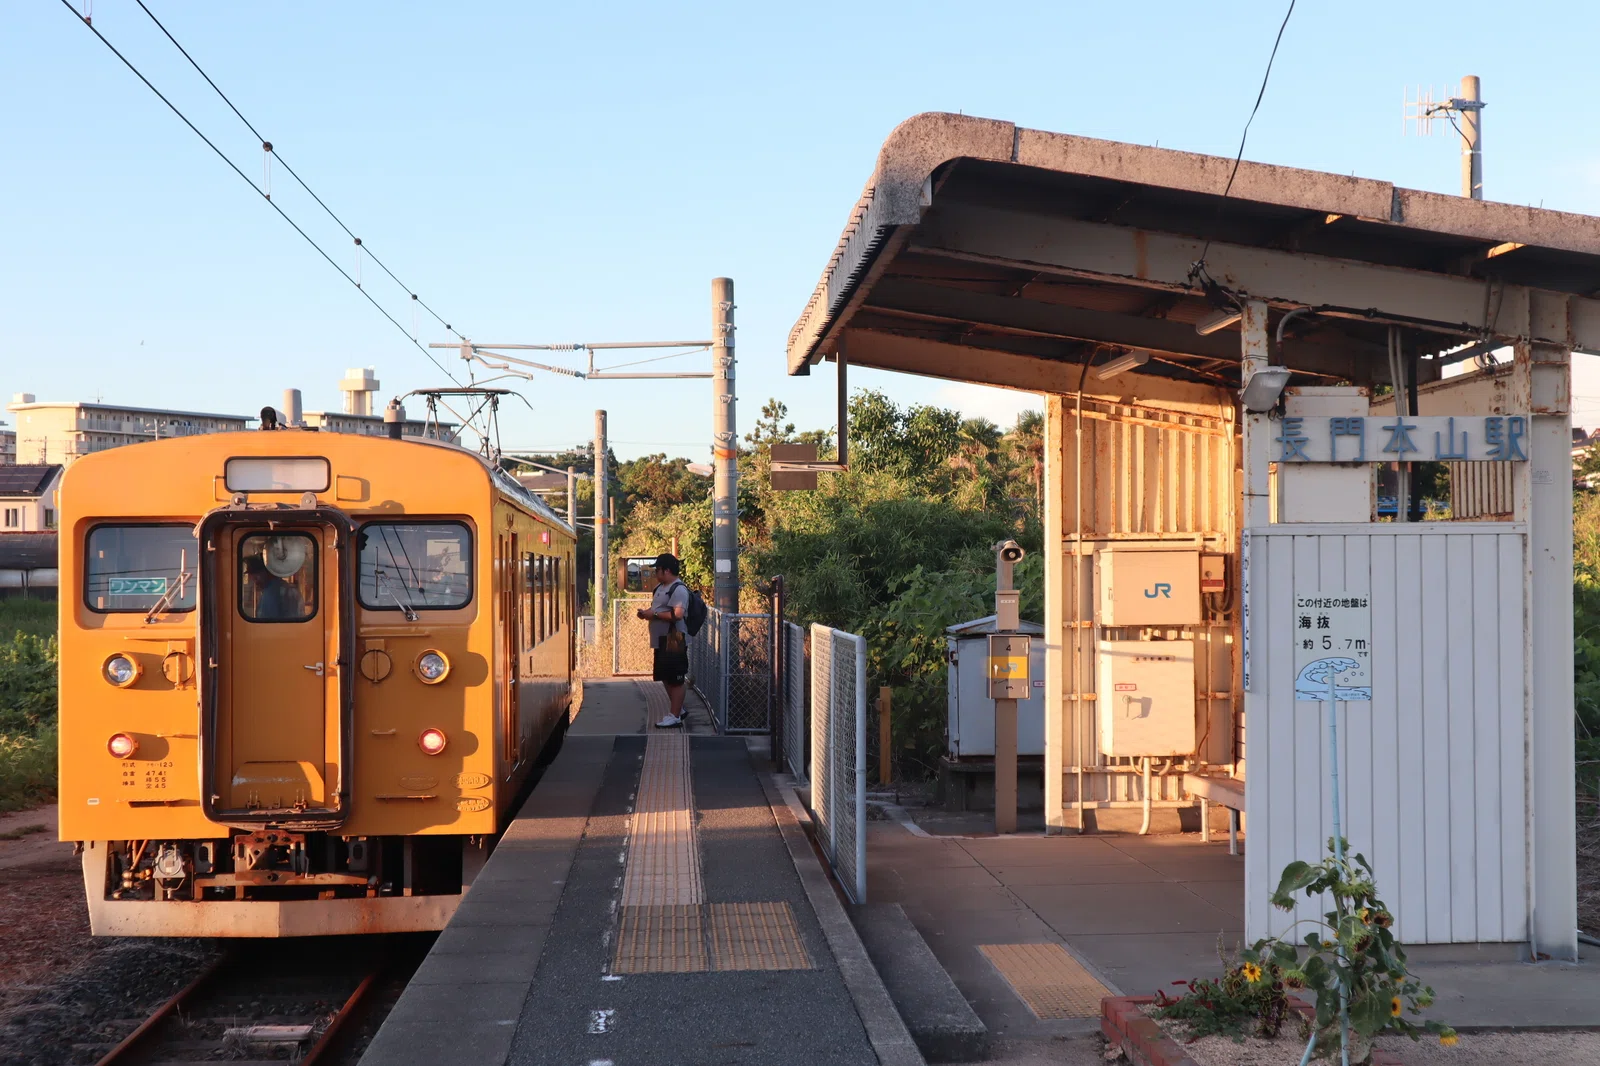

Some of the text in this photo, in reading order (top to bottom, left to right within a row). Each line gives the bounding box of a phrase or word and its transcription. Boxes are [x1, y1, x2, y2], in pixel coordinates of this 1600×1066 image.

[1276, 416, 1528, 462] 長門本山駅
[111, 580, 164, 592] ワンマン
[1144, 583, 1172, 598] JR
[1297, 598, 1368, 608] この付近の地盤は
[1298, 615, 1330, 629] 海抜
